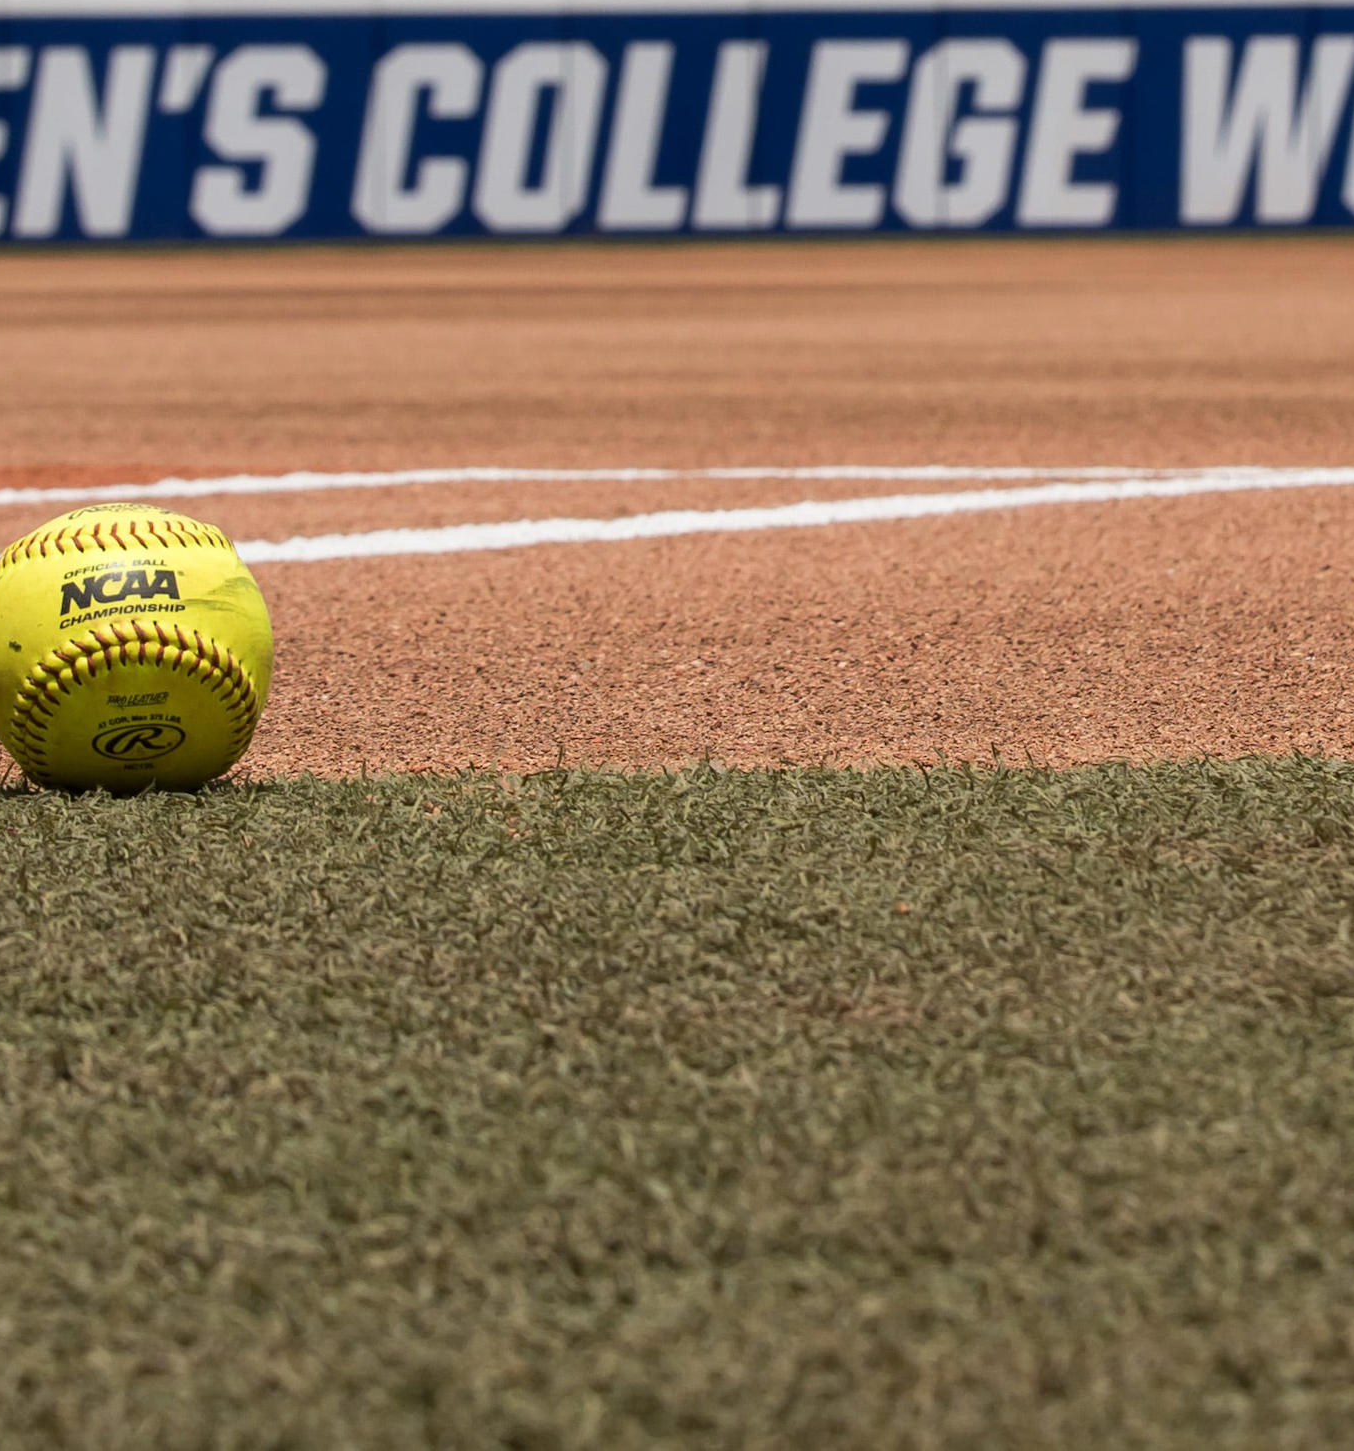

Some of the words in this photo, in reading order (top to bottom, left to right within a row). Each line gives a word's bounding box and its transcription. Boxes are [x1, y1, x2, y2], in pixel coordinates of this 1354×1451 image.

[351, 39, 1138, 232] COLLEGE
[63, 560, 126, 579] OFFICIAL
[132, 559, 167, 567] BALL
[60, 570, 180, 615] NCAA
[59, 604, 186, 629] CHAMPIONSHIP
